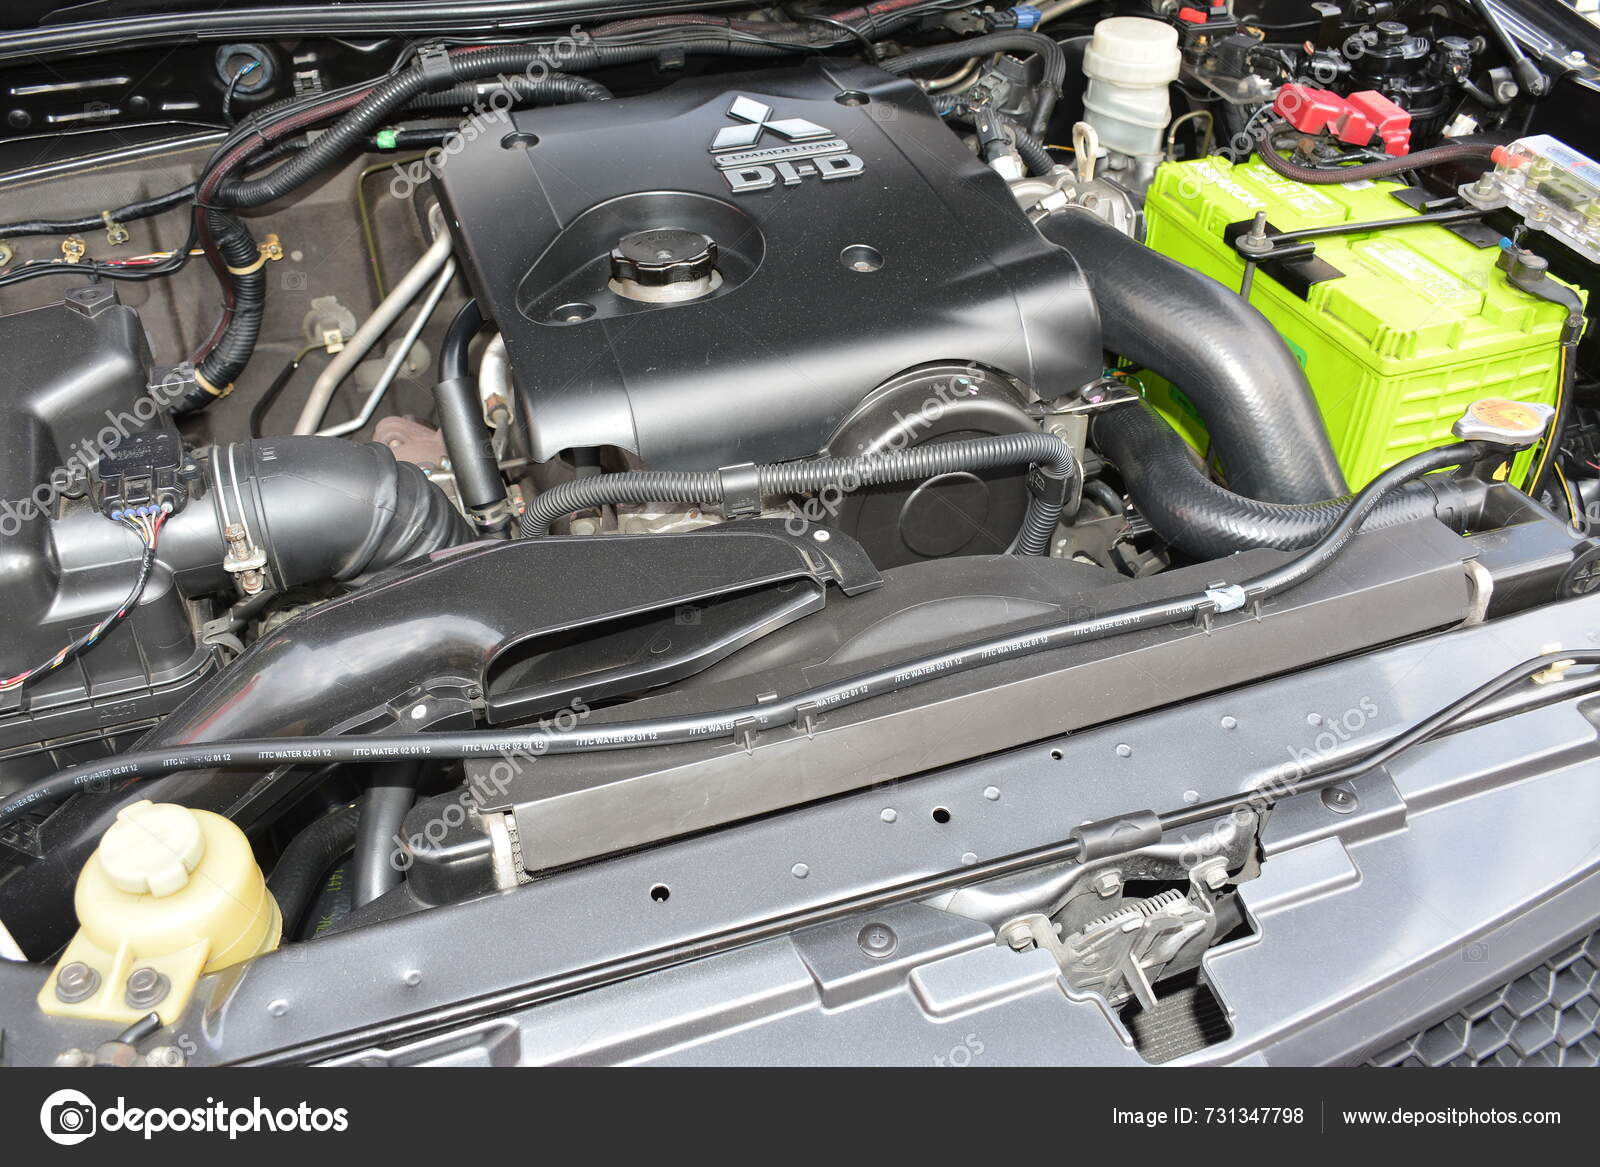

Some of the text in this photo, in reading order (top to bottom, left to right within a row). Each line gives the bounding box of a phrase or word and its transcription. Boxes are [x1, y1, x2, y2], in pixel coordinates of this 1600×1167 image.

[1089, 620, 1114, 633] WATER
[996, 642, 1022, 656] WATER
[1022, 640, 1031, 649] 02
[1031, 638, 1039, 647] 01
[1040, 636, 1049, 644] 12
[910, 665, 936, 679] WATER
[936, 662, 945, 672] 02
[946, 660, 954, 668] 01
[954, 657, 963, 665] 12
[841, 692, 850, 700] 02
[850, 688, 859, 697] 01
[860, 685, 869, 693] 12
[594, 734, 626, 744] WATER
[626, 733, 637, 742] 02
[637, 733, 646, 741] 01
[648, 731, 658, 740] 12
[370, 747, 400, 756] WATER
[400, 746, 411, 754] 02
[411, 746, 420, 754] 01
[422, 745, 431, 754] 12
[480, 743, 511, 752] WATER
[512, 742, 523, 750] 02
[523, 741, 533, 750] 01
[534, 741, 545, 749] 12
[223, 753, 232, 761] 12
[275, 750, 302, 759] WATER
[302, 749, 312, 757] 02
[312, 748, 322, 757] 01
[322, 748, 332, 757] 12
[112, 768, 121, 776] 02
[121, 766, 130, 774] 01
[130, 764, 139, 772] 12
